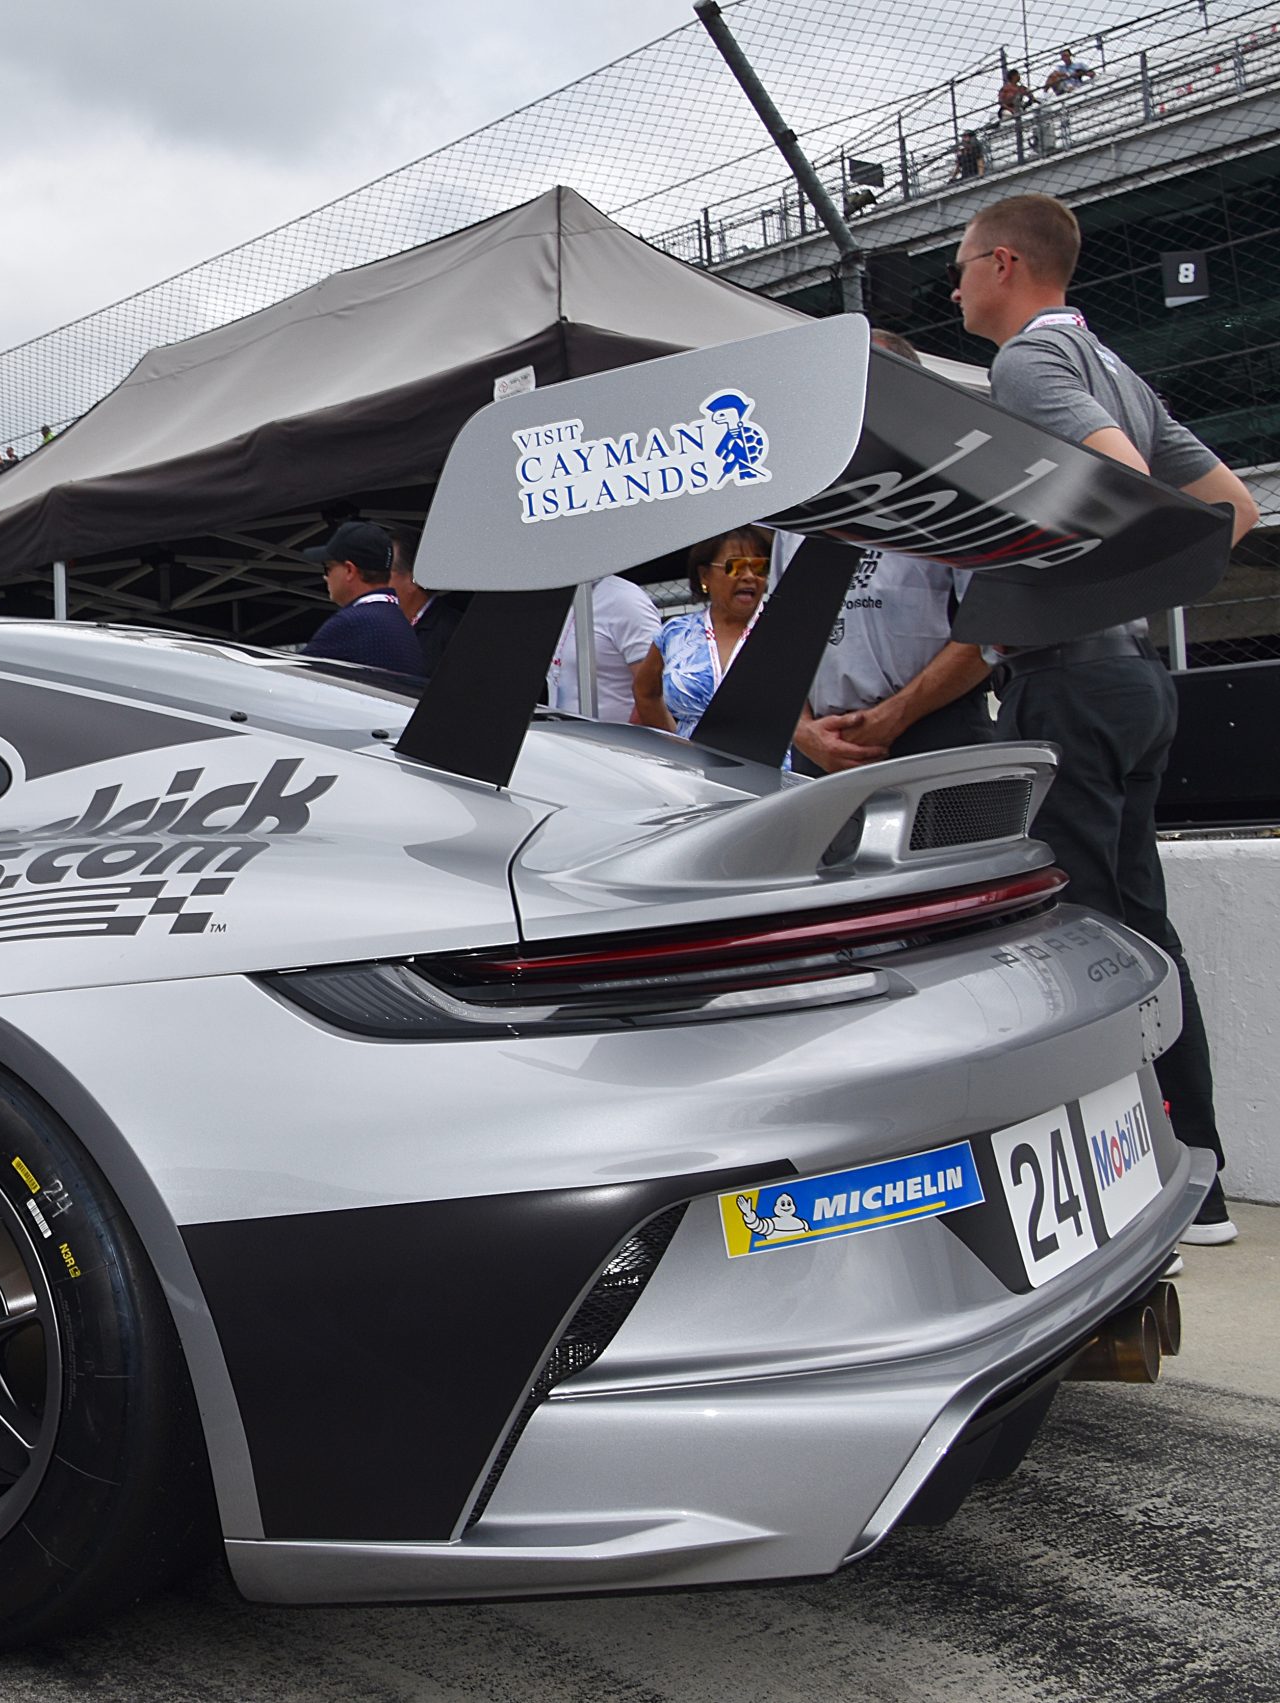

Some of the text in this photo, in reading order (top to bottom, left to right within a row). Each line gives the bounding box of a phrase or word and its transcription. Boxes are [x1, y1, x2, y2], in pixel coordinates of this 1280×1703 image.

[1177, 263, 1195, 283] 8
[518, 423, 580, 450] VISIT
[520, 425, 705, 483] CAYMAN
[523, 461, 710, 518] ISLANDS
[1087, 957, 1120, 983] GT3
[1090, 1110, 1140, 1191] Mobil
[812, 1166, 964, 1222] MICHELIN
[1009, 1127, 1084, 1263] 24
